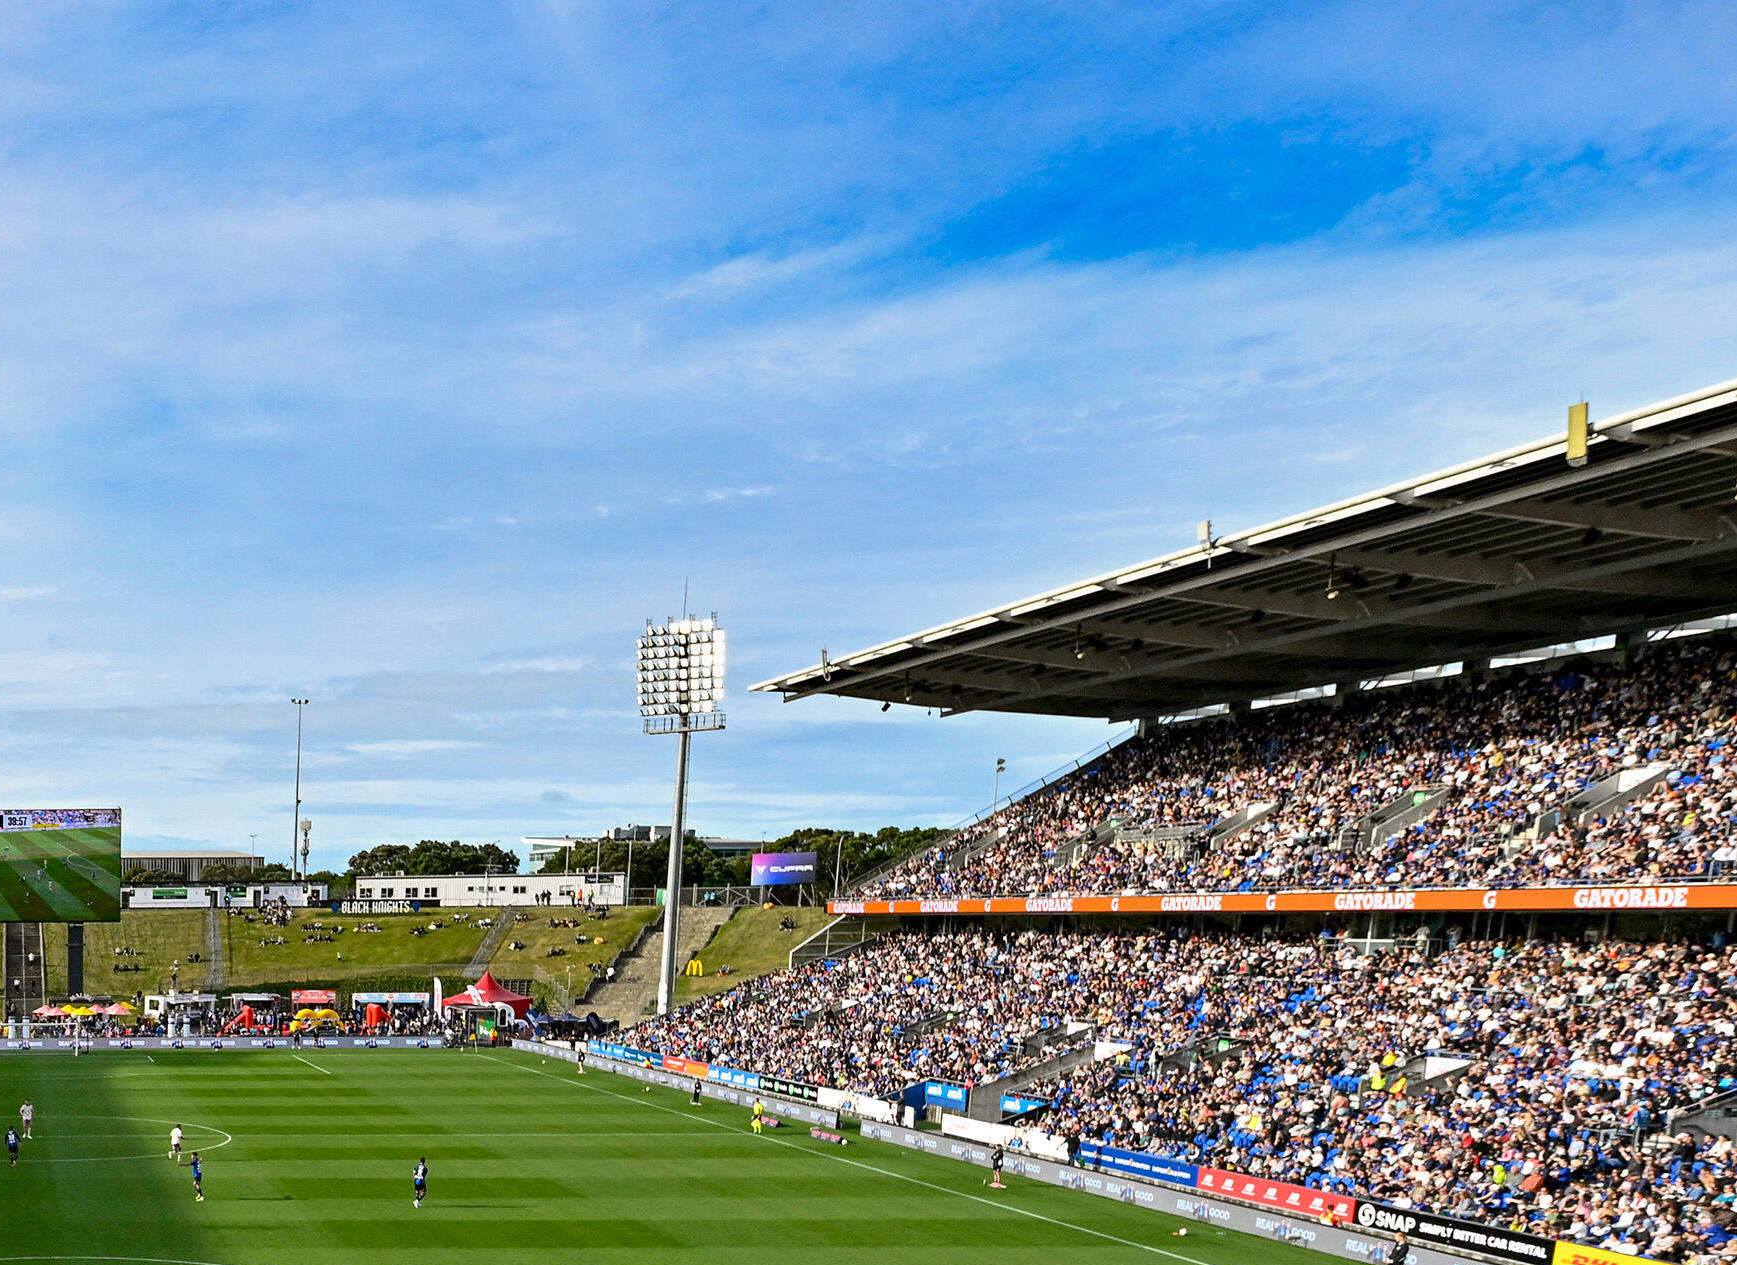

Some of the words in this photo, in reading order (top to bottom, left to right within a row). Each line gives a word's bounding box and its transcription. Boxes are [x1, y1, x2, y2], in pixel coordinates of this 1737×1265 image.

[7, 816, 27, 827] 39:57
[1025, 899, 1074, 912] GATORADE
[1160, 896, 1222, 911] GATORADE
[1265, 895, 1276, 910] G
[1334, 893, 1416, 910] GATORADE
[1483, 890, 1497, 909] G
[1573, 887, 1689, 908] GATORADE
[341, 901, 370, 914] BLACK
[371, 900, 410, 914] KNIGHTS
[833, 902, 864, 914] GATORADE
[920, 901, 958, 913] GATORADE
[1059, 1171, 1074, 1181] REAL
[1085, 1177, 1102, 1188] GOOD
[1106, 1182, 1122, 1194] REAL
[1135, 1191, 1154, 1202] GOOD
[1176, 1200, 1195, 1213] REAL
[1209, 1209, 1230, 1221] GOOD
[1256, 1217, 1274, 1231] REAL
[1291, 1228, 1315, 1241] GOOD
[1375, 1209, 1416, 1233] SNAP
[1345, 1239, 1369, 1254] REAL
[1419, 1221, 1453, 1239] SIMPLY
[1453, 1228, 1487, 1245] BETTER
[1487, 1235, 1508, 1249] CAR
[1508, 1240, 1548, 1259] RENTAL
